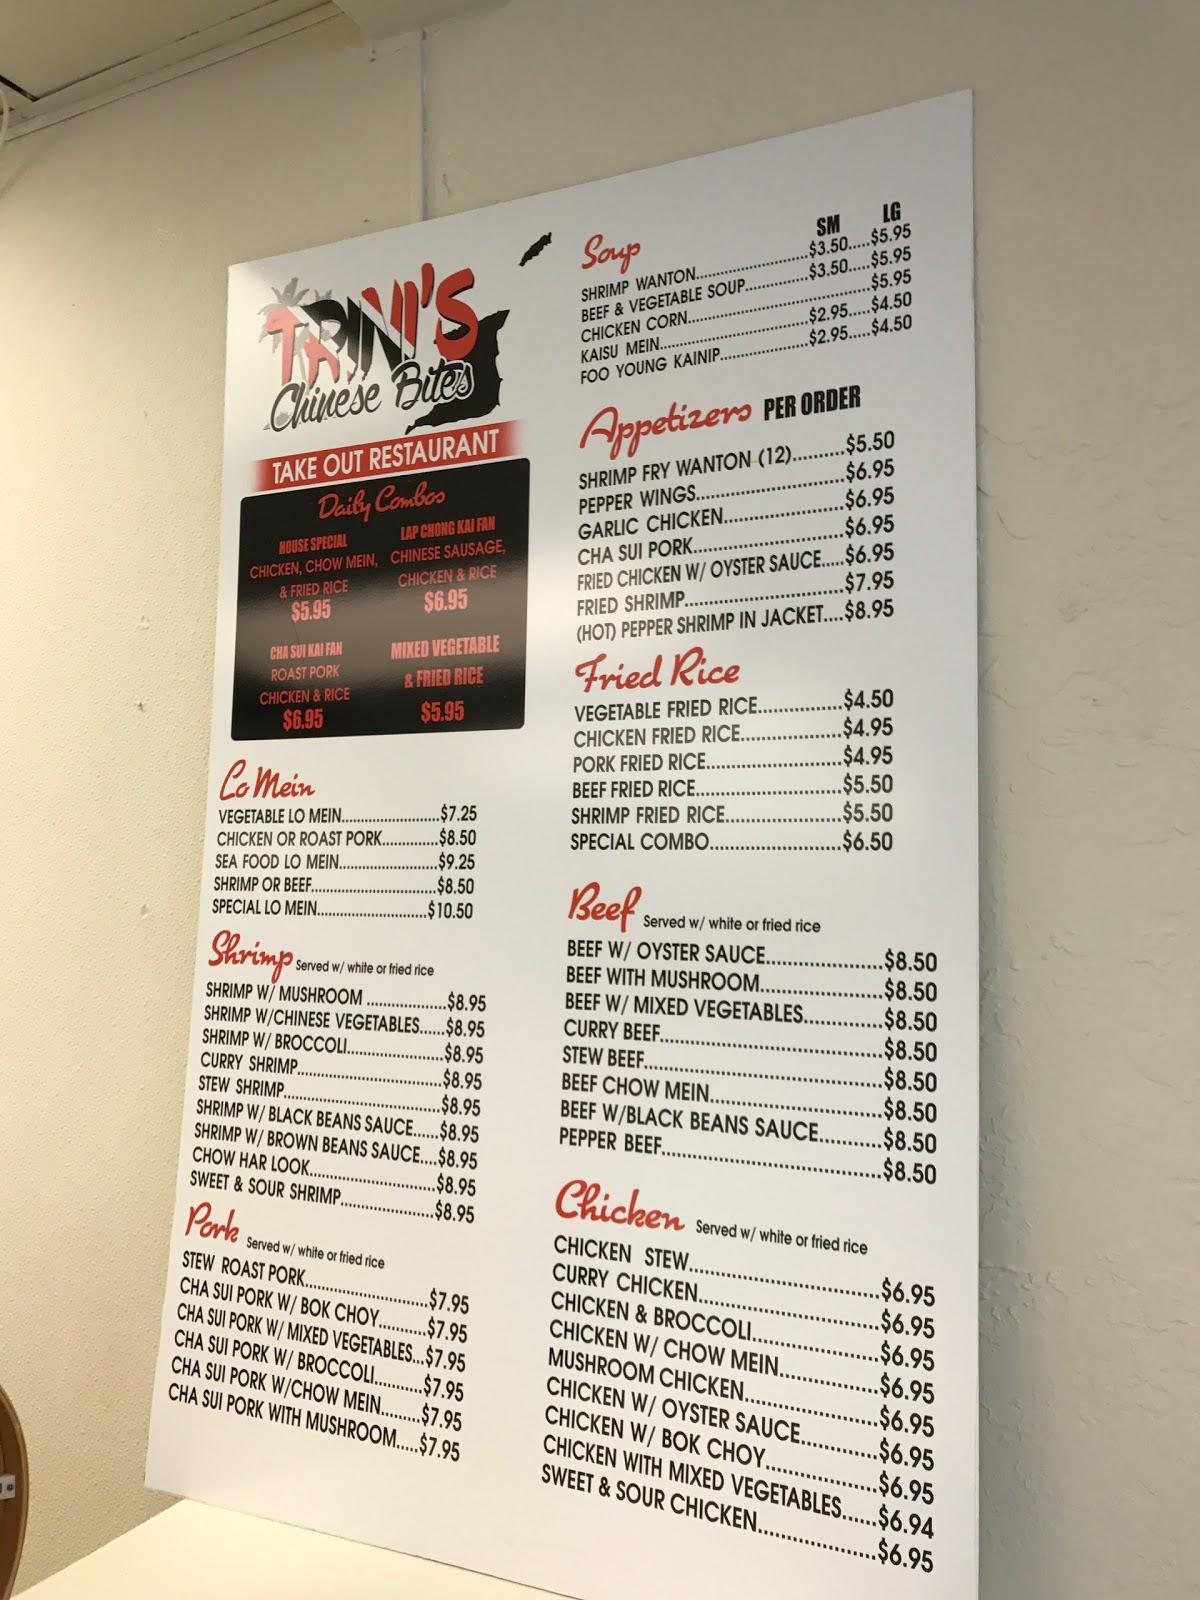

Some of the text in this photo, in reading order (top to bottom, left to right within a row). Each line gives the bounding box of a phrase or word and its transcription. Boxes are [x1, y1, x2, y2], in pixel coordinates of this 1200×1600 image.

[883, 201, 900, 222] LG
[817, 214, 840, 236] SM
[582, 234, 641, 273] Soup
[581, 280, 629, 302] SHRIMP
[581, 286, 702, 322] BEEF & VEGETABLE
[581, 319, 640, 342] CHICKEN
[581, 344, 618, 363] KAISU
[581, 356, 667, 384] FOO YOUNG
[270, 359, 474, 432] Chinese Bites
[764, 385, 860, 420] PER ORDER
[580, 403, 752, 460] Appetizers
[272, 428, 499, 484] TAKE OUT RESTAURANT
[579, 450, 751, 490] SHRIMP FRY WANTON
[319, 480, 446, 521] Daily Combos
[579, 492, 633, 515] PEPPER
[401, 516, 495, 540] LAP CHONG KAI FAN
[578, 517, 638, 540] GARLIC
[279, 534, 347, 554] HOUSE SPECIAL
[390, 546, 441, 563] CHINESE
[578, 543, 642, 565] CHA SUI
[306, 559, 342, 574] CHOW
[398, 565, 495, 588] CHICKEN & RICE
[578, 556, 765, 590] FRIED CHICKEN W/ OYSTER
[279, 579, 347, 599] & FRIED RICE
[425, 588, 468, 612] $6.95
[291, 600, 331, 623] $5.95
[577, 597, 618, 616] FRIED
[577, 610, 756, 643] (HOT) PEPPER SHRIMP IN
[270, 642, 342, 660] CHA SUI KAI FAN
[391, 635, 500, 659] MIXED VEGETABLE
[271, 664, 340, 681] ROAST PORK
[404, 667, 483, 688] & FRIED RICE
[575, 645, 740, 693] Fried Rice
[260, 688, 350, 705] CHICKEN & RICE
[283, 709, 324, 731] $6.95
[421, 701, 465, 723] $5.95
[574, 699, 711, 721] VEGETABLE FRIED
[574, 726, 696, 747] CHICKEN FRIED
[573, 754, 663, 773] PORK FRIED
[219, 759, 313, 800] Lo Mein
[573, 780, 653, 798] BEEF FRIED
[219, 808, 305, 824] VEGETABLE LO
[571, 806, 680, 824] SHRIMP FRIED
[217, 831, 342, 846] CHICKEN OR ROAST
[570, 833, 634, 850] SPECIAL
[215, 853, 301, 869] SEA FOOD LO
[214, 876, 280, 892] SHRIMP OR
[212, 898, 281, 915] SPECIAL LO
[568, 881, 641, 933] Beef
[643, 914, 820, 932] Served w/ white or fried rice
[208, 930, 293, 983] Shrimp
[567, 939, 699, 961] BEEF W/ OYSTER
[295, 959, 434, 976] Served w/ white or fried rice
[566, 966, 645, 986] BEEF WITH
[206, 982, 362, 1005] SHRIMP W/ MUSHROOM
[204, 1005, 251, 1022] SHRIMP
[564, 1019, 619, 1039] CURRY
[563, 1045, 603, 1065] STEW
[190, 1170, 285, 1197] SWEET & SOUR
[555, 1179, 685, 1231] Chicken
[185, 1201, 239, 1243] Pork
[696, 1219, 868, 1255] Served w/ white or fried rice
[246, 1236, 384, 1269] Served w/ white or fried rice
[182, 1250, 265, 1280] STEW ROAST
[177, 1303, 328, 1346] CHA SUI PORK W/ MIXED
[548, 1347, 654, 1385] MUSHROOM
[546, 1376, 729, 1429] CHICKEN W/ OYSTER
[543, 1434, 724, 1491] CHICKEN WITH MIXED
